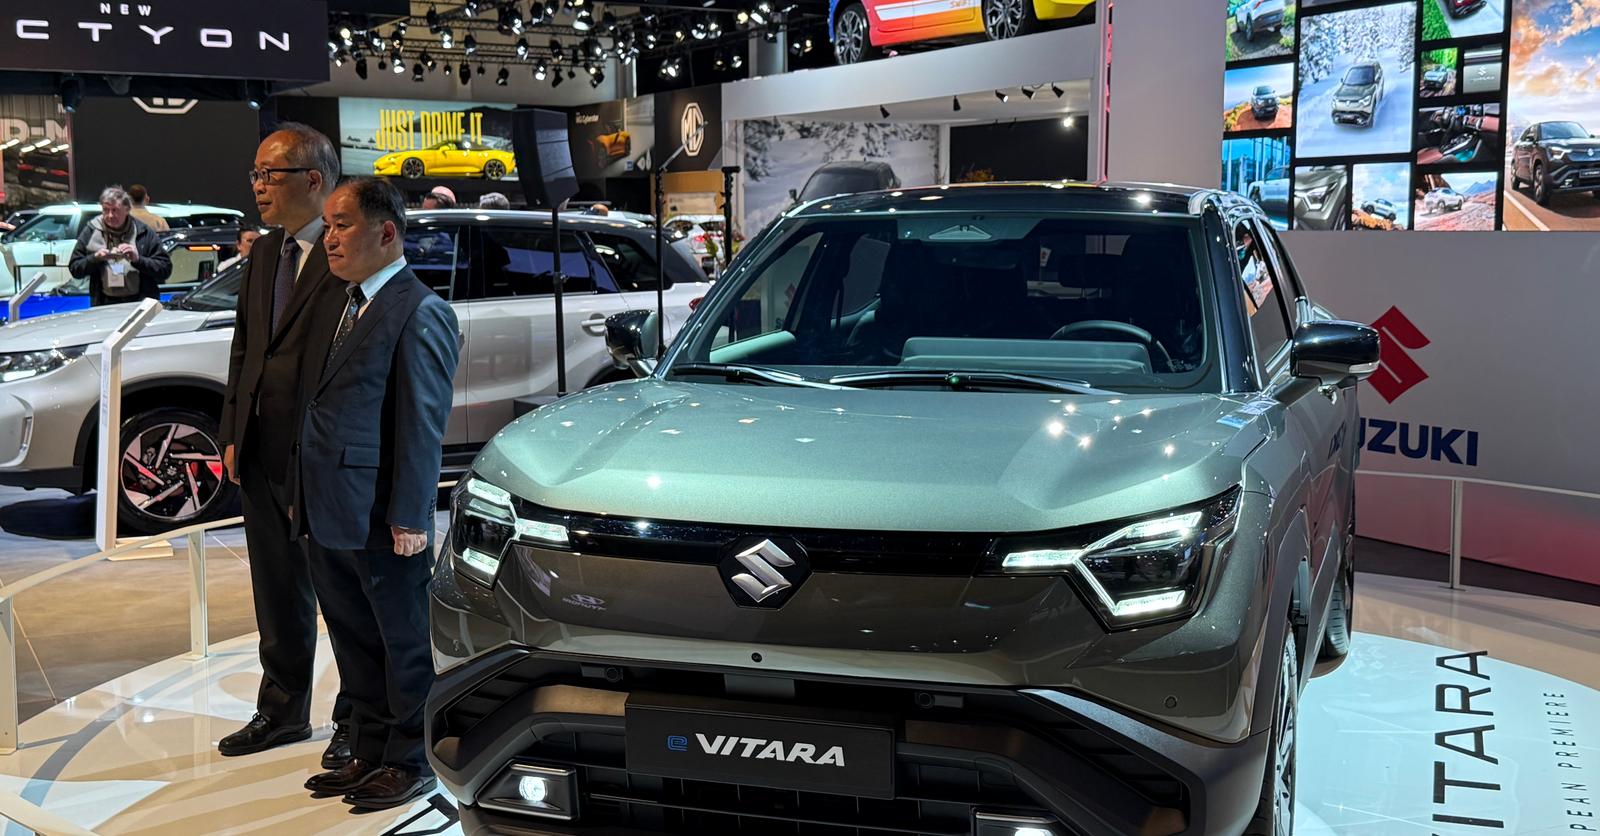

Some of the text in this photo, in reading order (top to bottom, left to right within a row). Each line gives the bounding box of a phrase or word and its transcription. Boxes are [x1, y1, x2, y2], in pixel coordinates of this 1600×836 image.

[100, 3, 151, 16] NEW
[16, 19, 290, 51] CTYON
[376, 109, 483, 150] JUST DRIVE IT
[695, 733, 846, 767] VITARA
[1432, 650, 1504, 836] ITARA
[1543, 692, 1598, 831] PEAN PREMIERE
